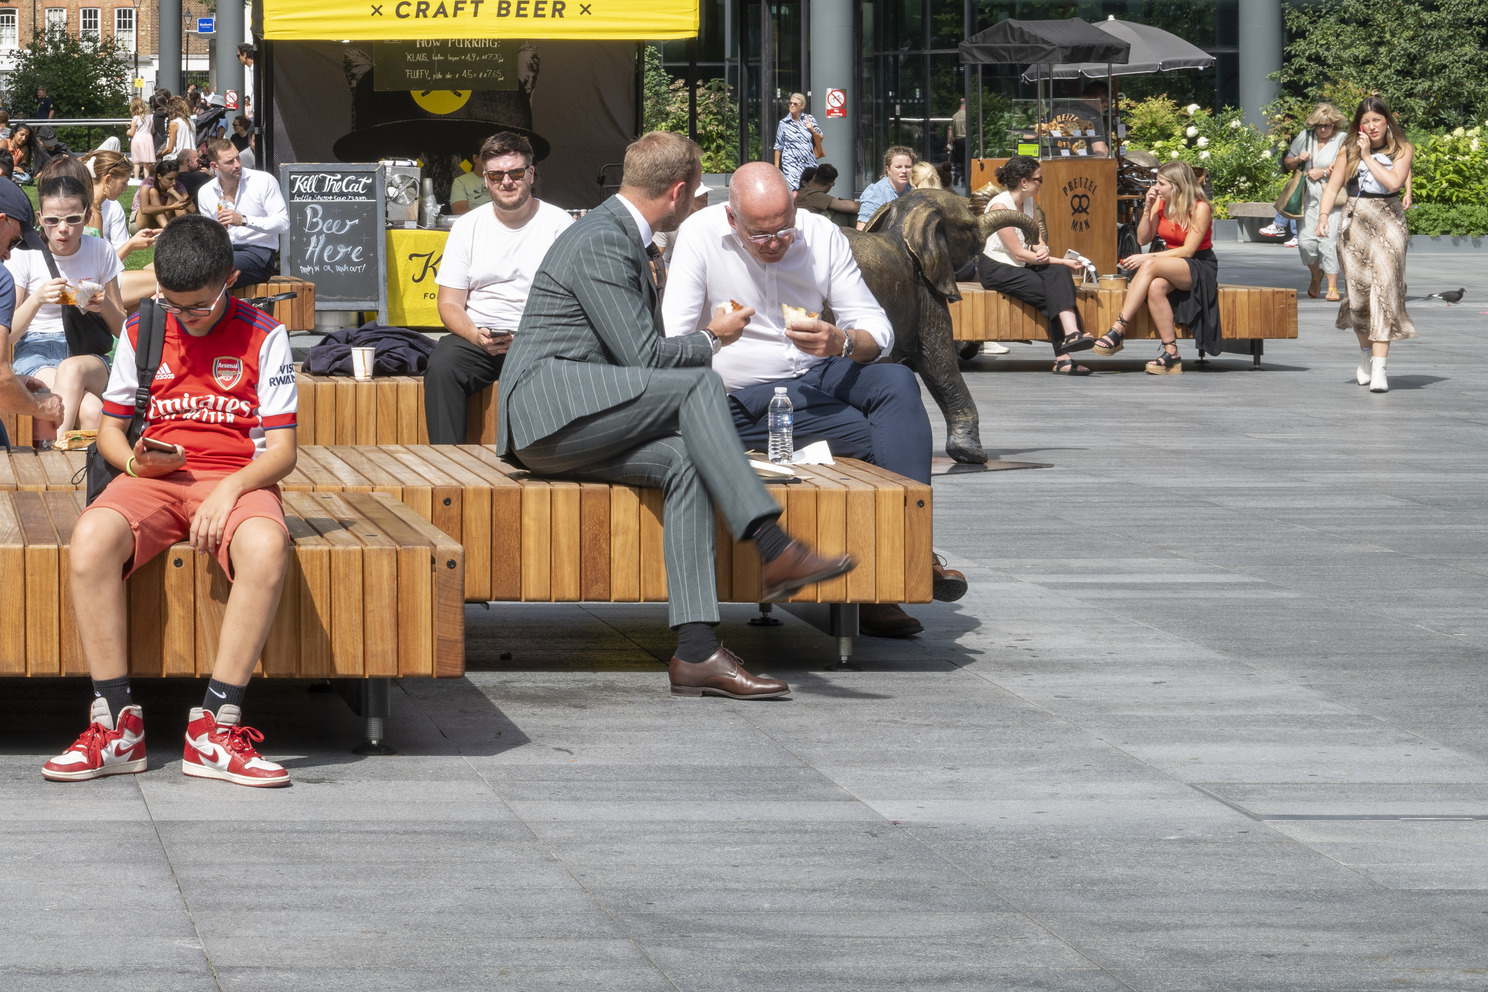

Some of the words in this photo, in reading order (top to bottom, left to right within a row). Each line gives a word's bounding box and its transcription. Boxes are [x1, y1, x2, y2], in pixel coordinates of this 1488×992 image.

[394, 0, 484, 20] CRAFT
[496, 0, 567, 19] BEER
[290, 174, 319, 194] Kill
[318, 173, 342, 193] The
[341, 175, 372, 194] Cat
[1062, 176, 1099, 197] PRETZEL
[303, 204, 359, 235] Beer
[1070, 218, 1091, 233] MAN
[304, 233, 364, 265] Here
[154, 372, 175, 381] adidas
[217, 362, 238, 370] Arsenal
[148, 392, 252, 420] Emirates
